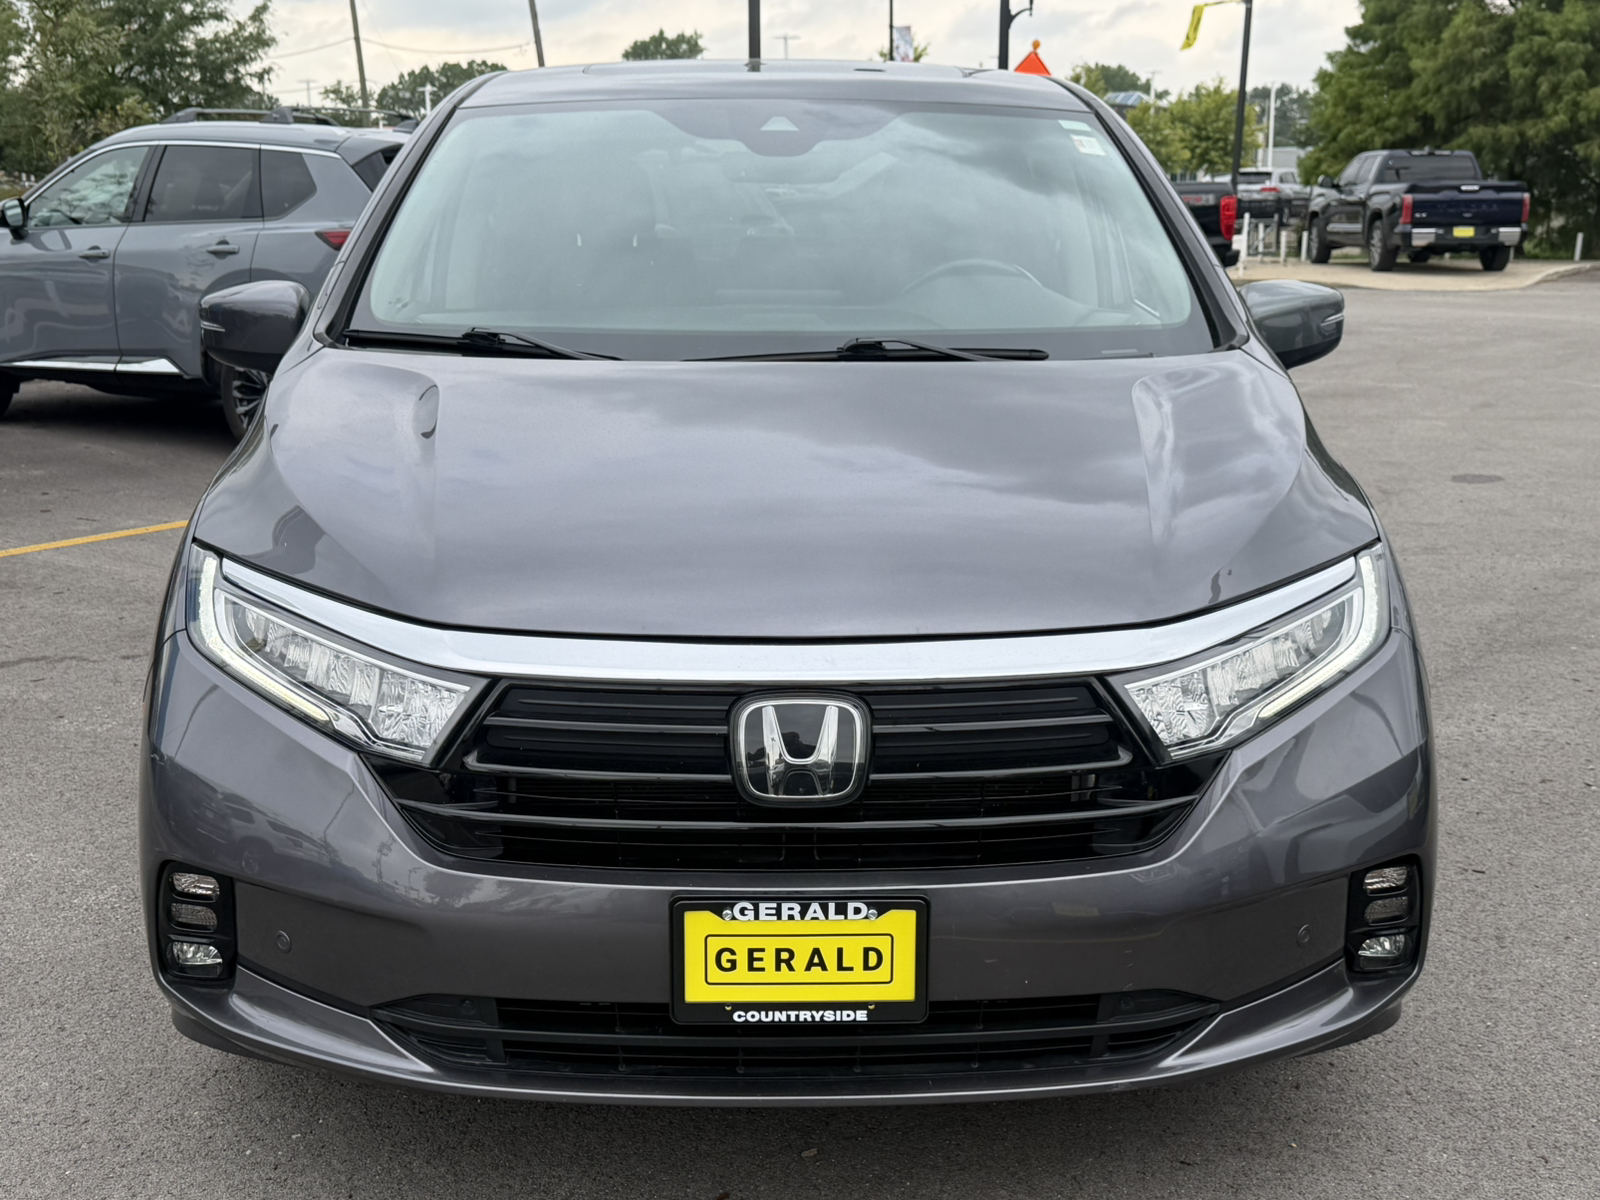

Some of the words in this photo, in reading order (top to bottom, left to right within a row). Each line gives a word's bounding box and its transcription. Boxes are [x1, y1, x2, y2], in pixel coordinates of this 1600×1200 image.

[732, 901, 868, 921] GERALD
[714, 946, 884, 973] GERALD
[732, 1010, 868, 1023] COUNTRYSIDE
